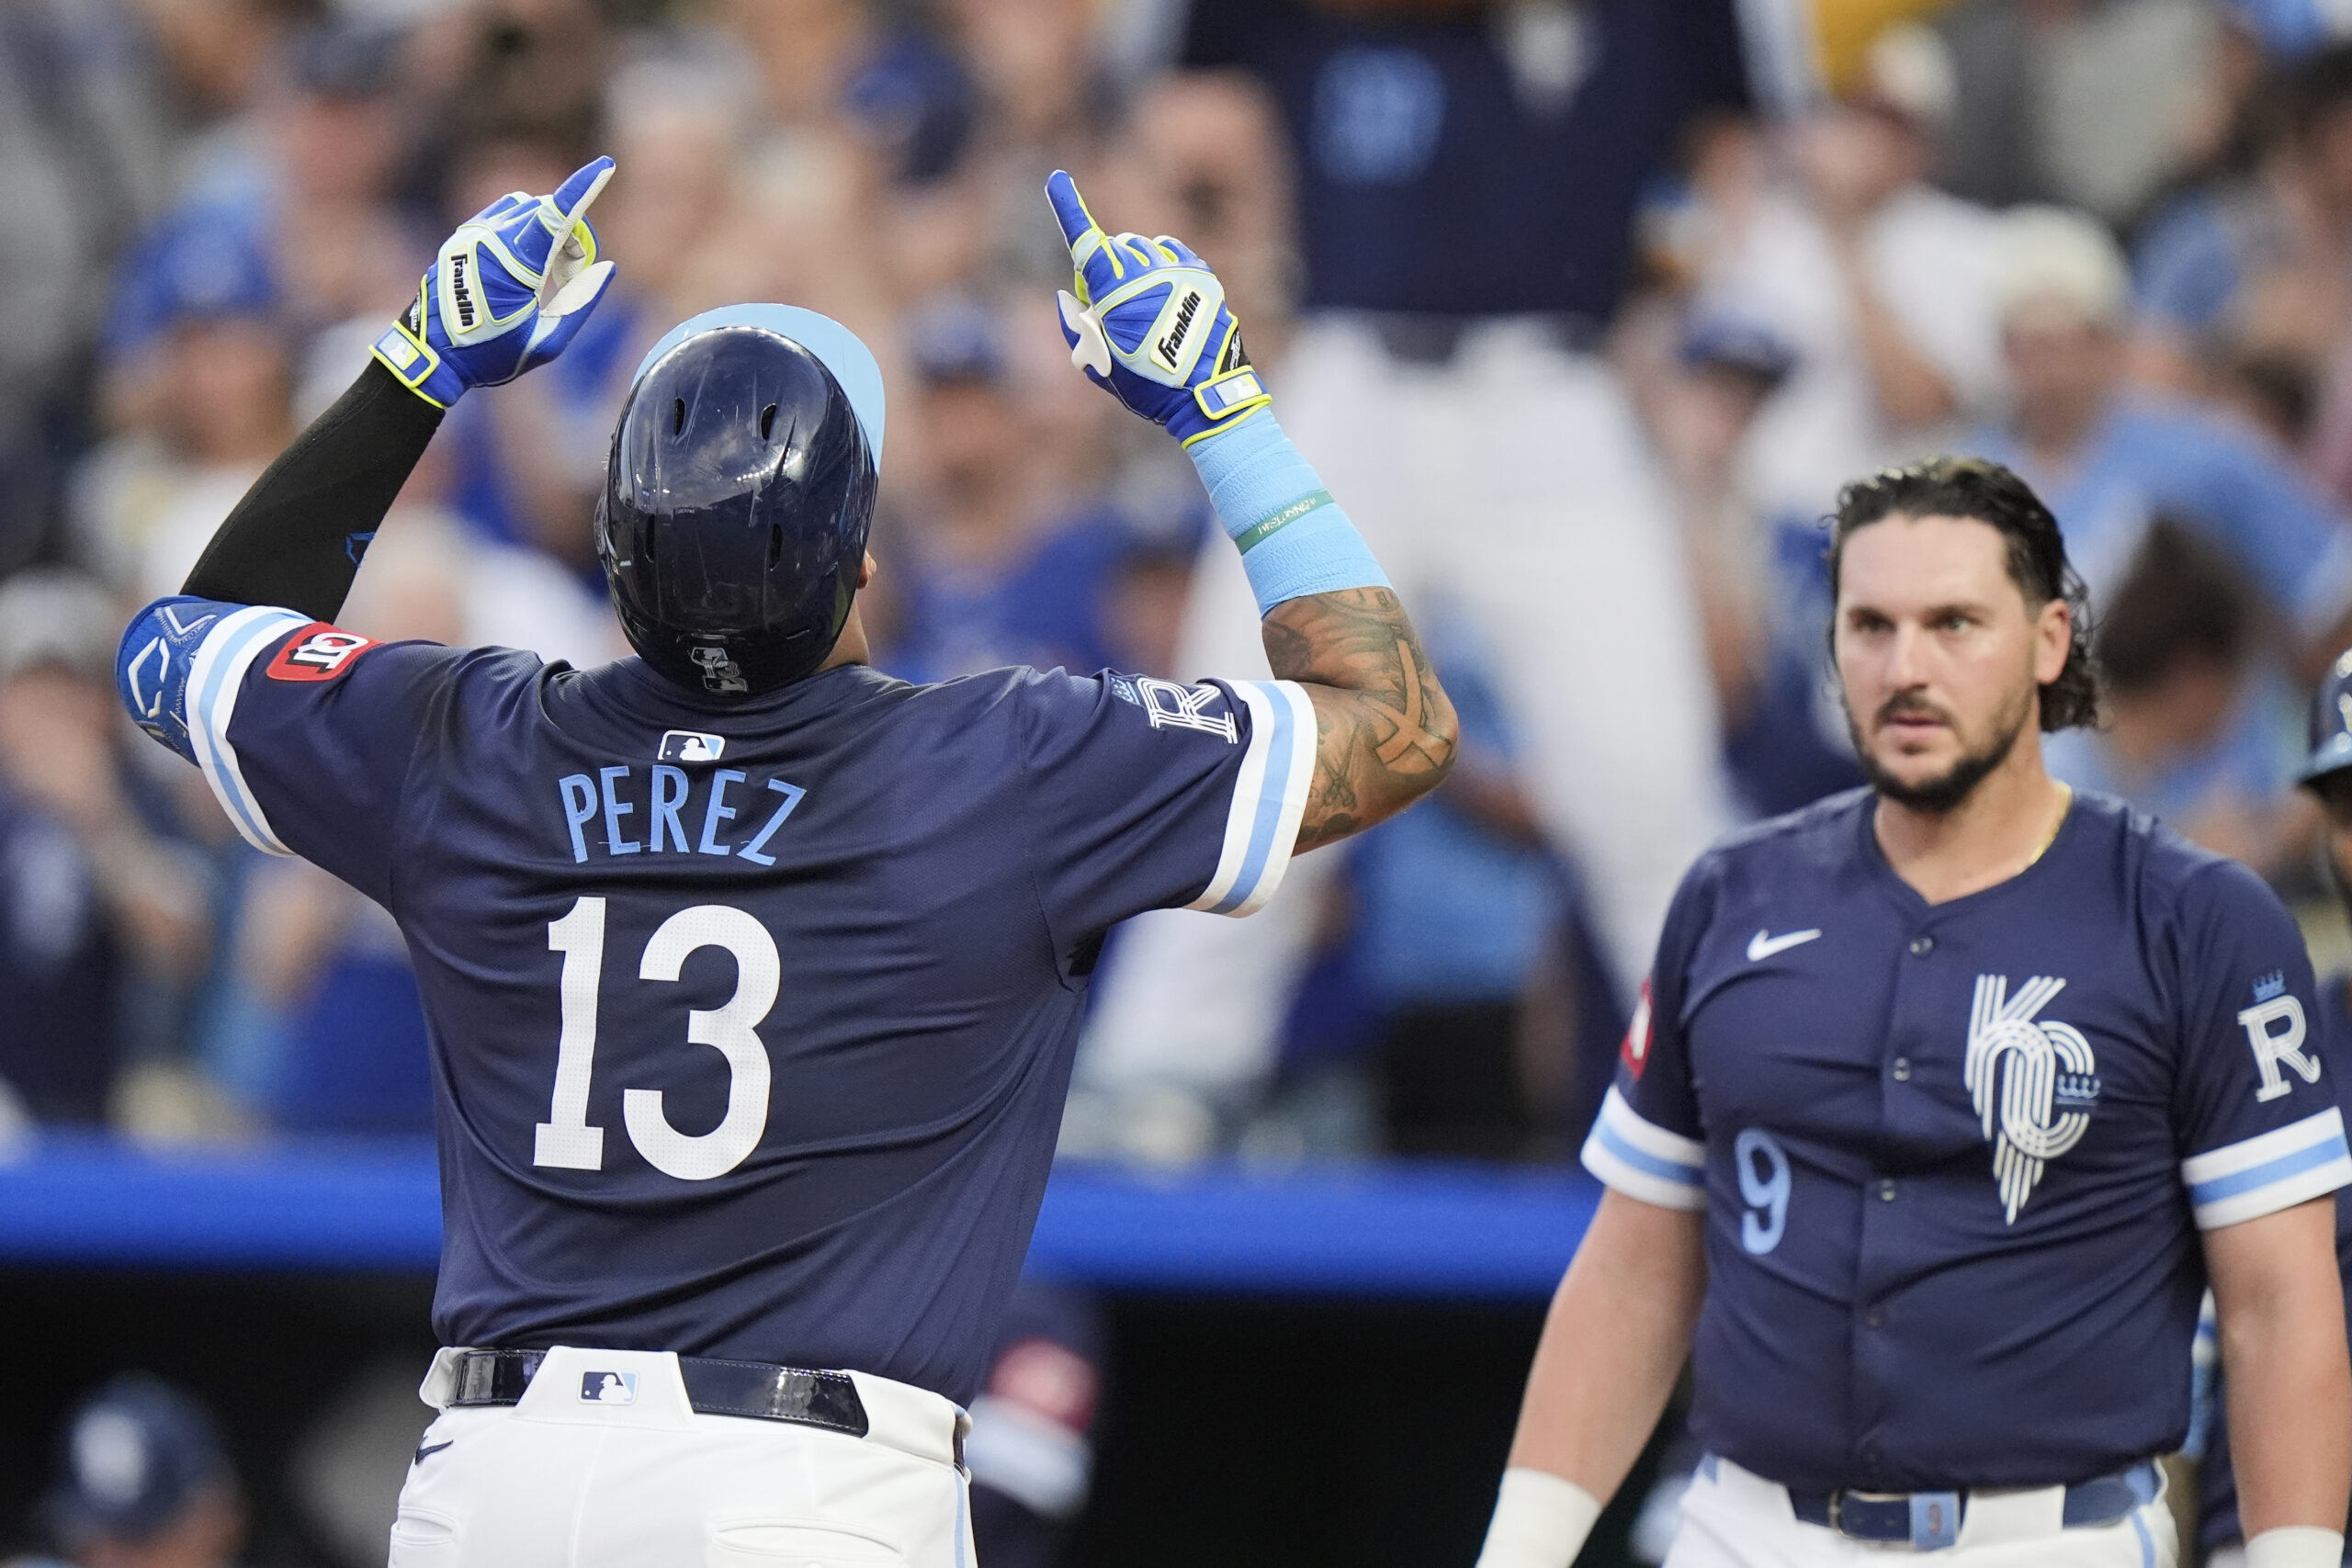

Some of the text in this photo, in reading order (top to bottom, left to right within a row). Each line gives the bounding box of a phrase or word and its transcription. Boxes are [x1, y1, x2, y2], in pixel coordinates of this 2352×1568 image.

[450, 254, 476, 327] Franklin
[1158, 290, 1201, 368] Franklin
[559, 764, 807, 866] PEREZ
[533, 897, 781, 1181] 13
[2237, 995, 2321, 1102] R
[1735, 1127, 1792, 1255] 9
